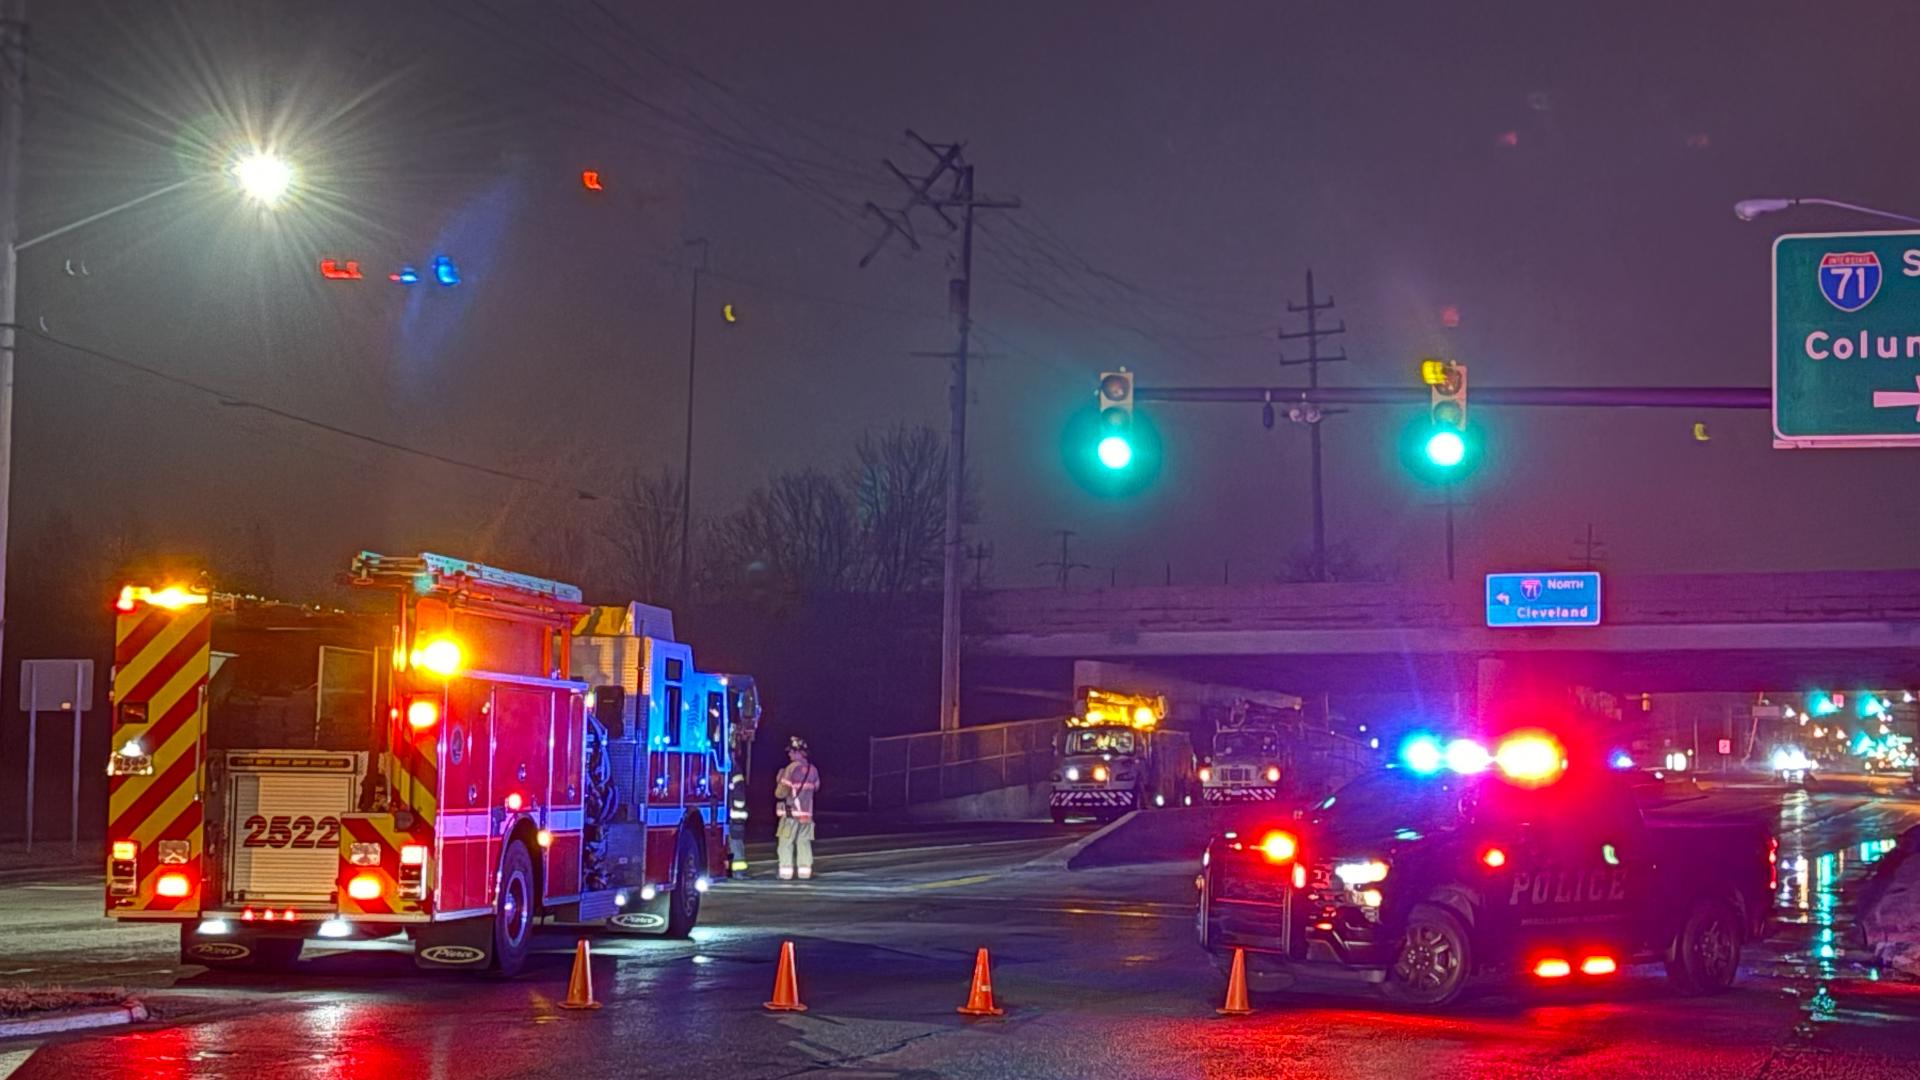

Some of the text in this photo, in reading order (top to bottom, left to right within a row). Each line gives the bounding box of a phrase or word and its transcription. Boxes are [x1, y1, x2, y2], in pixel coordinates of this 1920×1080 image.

[1830, 267, 1865, 300] 71
[1522, 584, 1537, 598] 71
[1547, 579, 1584, 590] NORTH
[1517, 606, 1588, 618] Cleveland
[243, 815, 341, 848] 2522
[1509, 871, 1626, 905] POLICE
